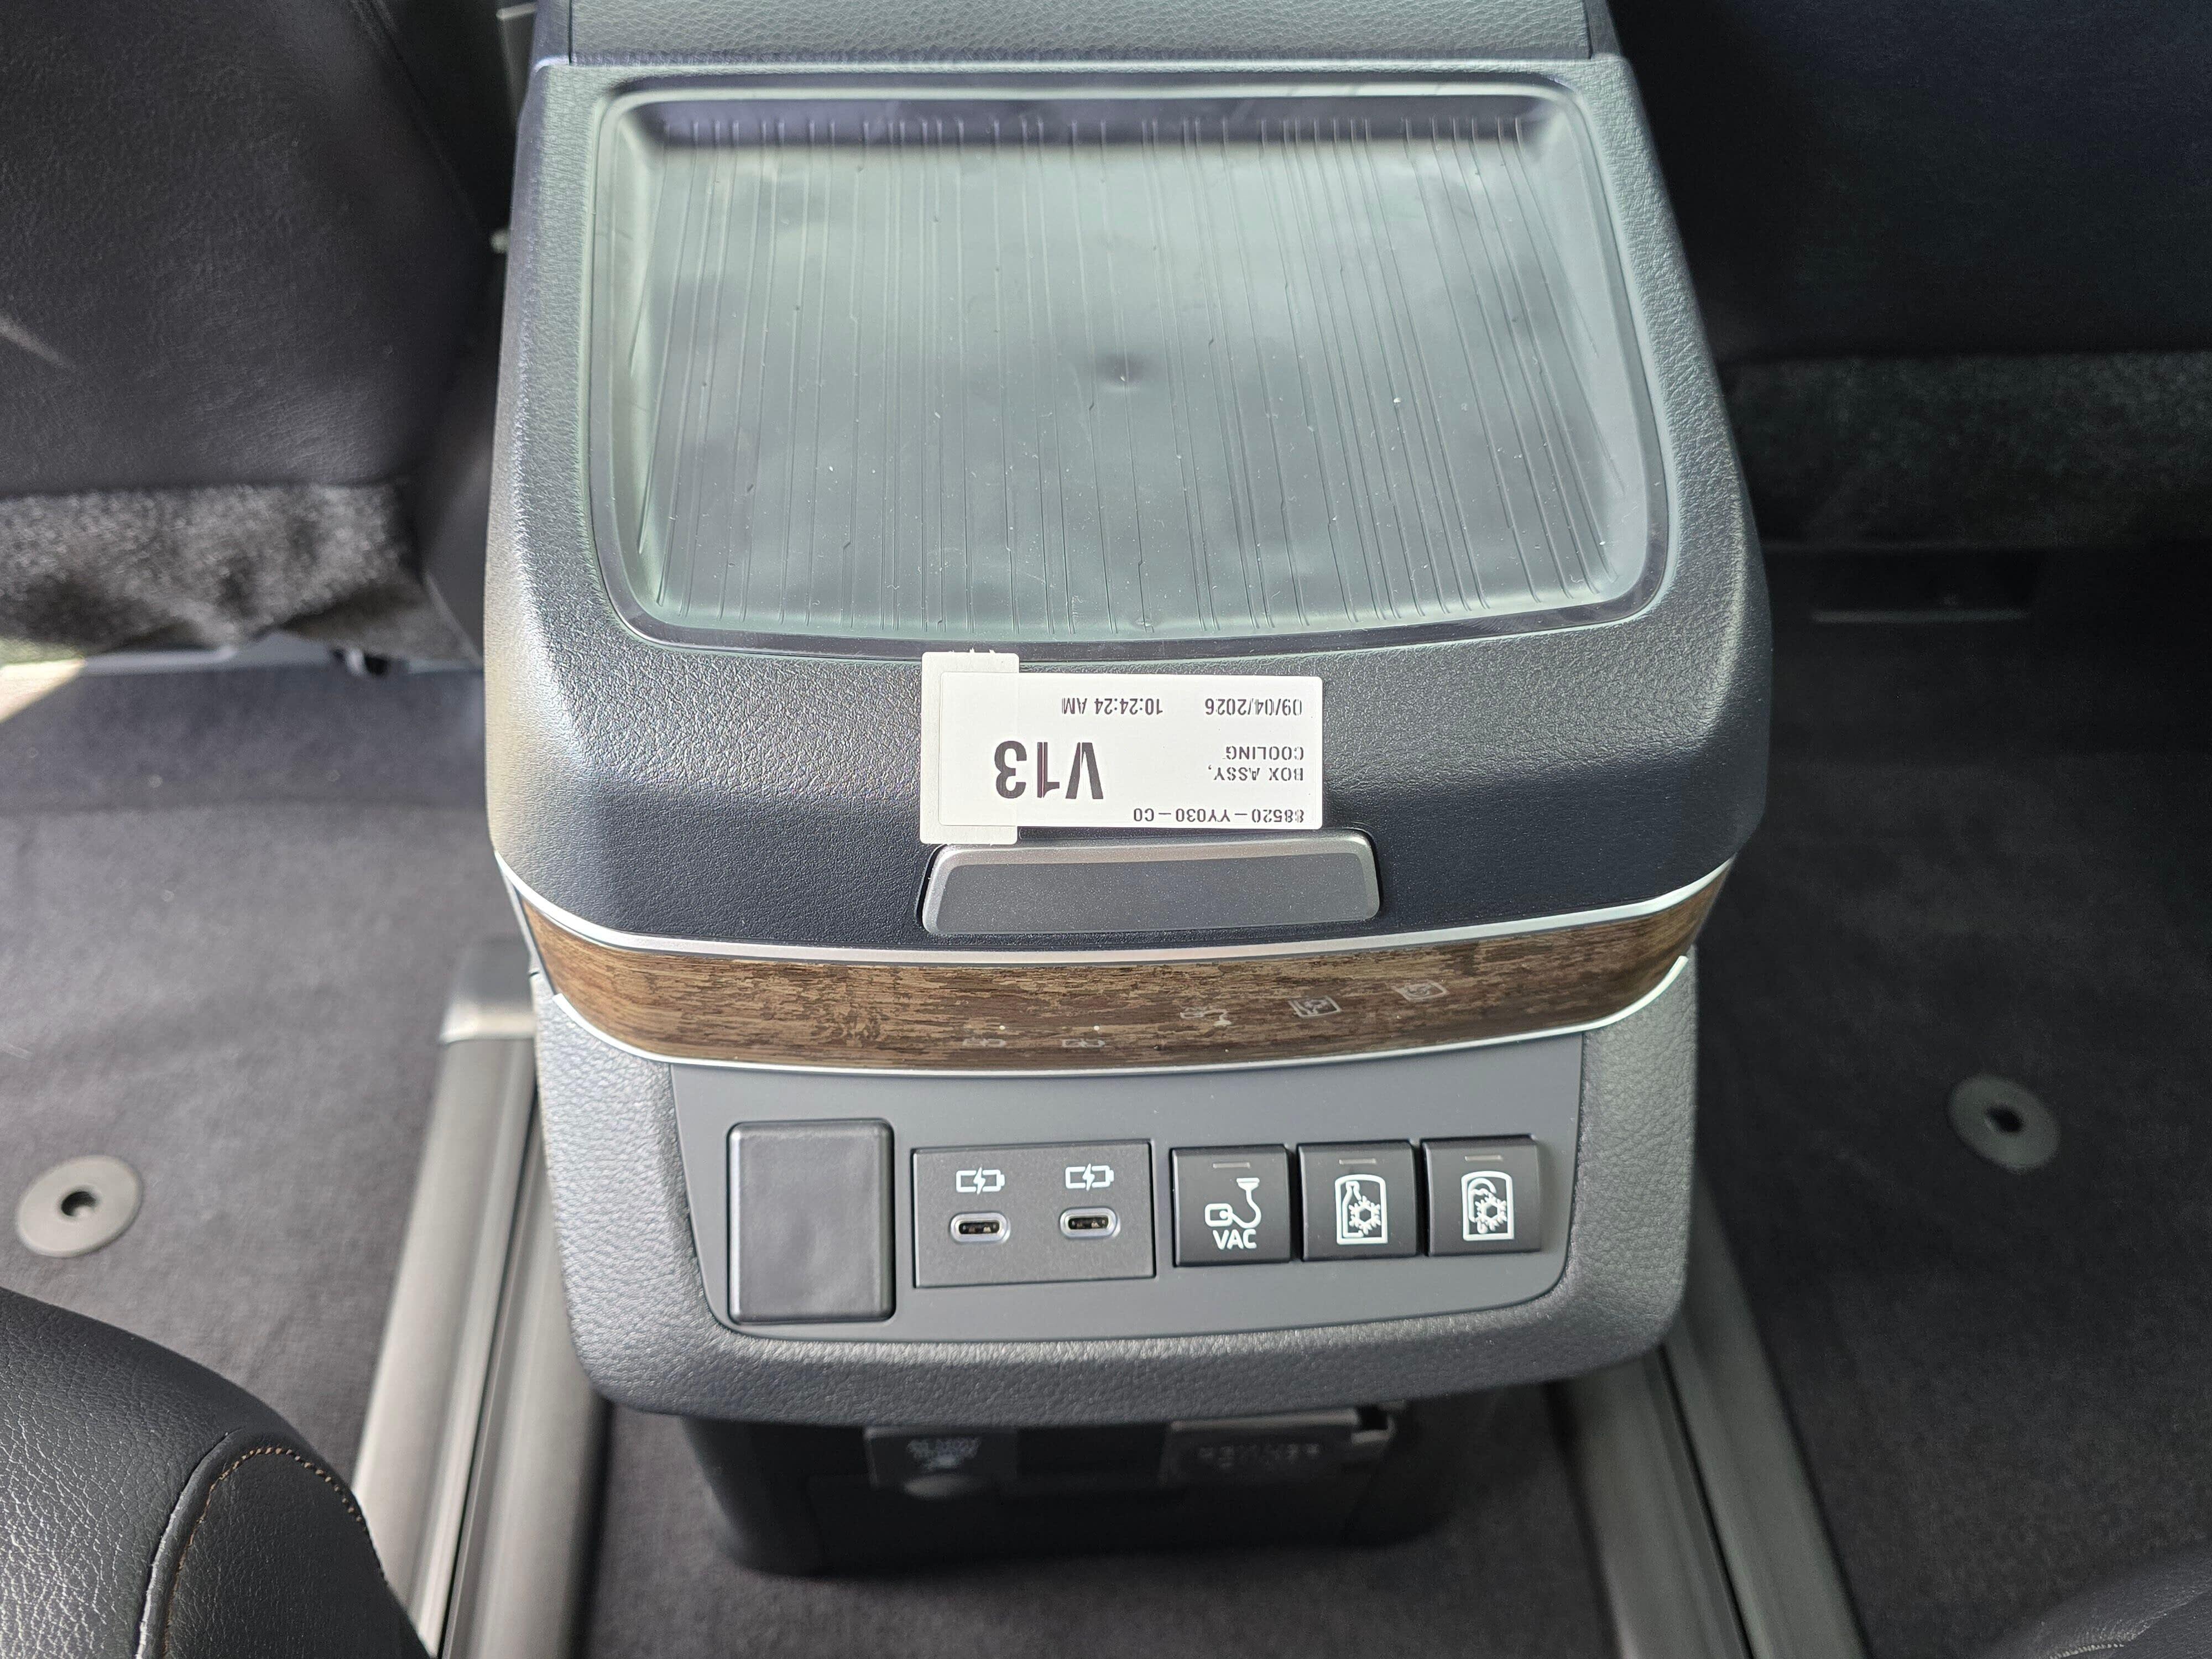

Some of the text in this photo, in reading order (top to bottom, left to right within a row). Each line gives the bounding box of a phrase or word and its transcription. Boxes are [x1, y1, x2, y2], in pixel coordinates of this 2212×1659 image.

[1062, 697, 1302, 716] 09/04/2026 10:24:24 AM
[1225, 745, 1304, 760] COOLING
[994, 740, 1104, 800] V13
[1208, 765, 1303, 781] BOX ASSY,
[1212, 1228, 1257, 1250] VAC
